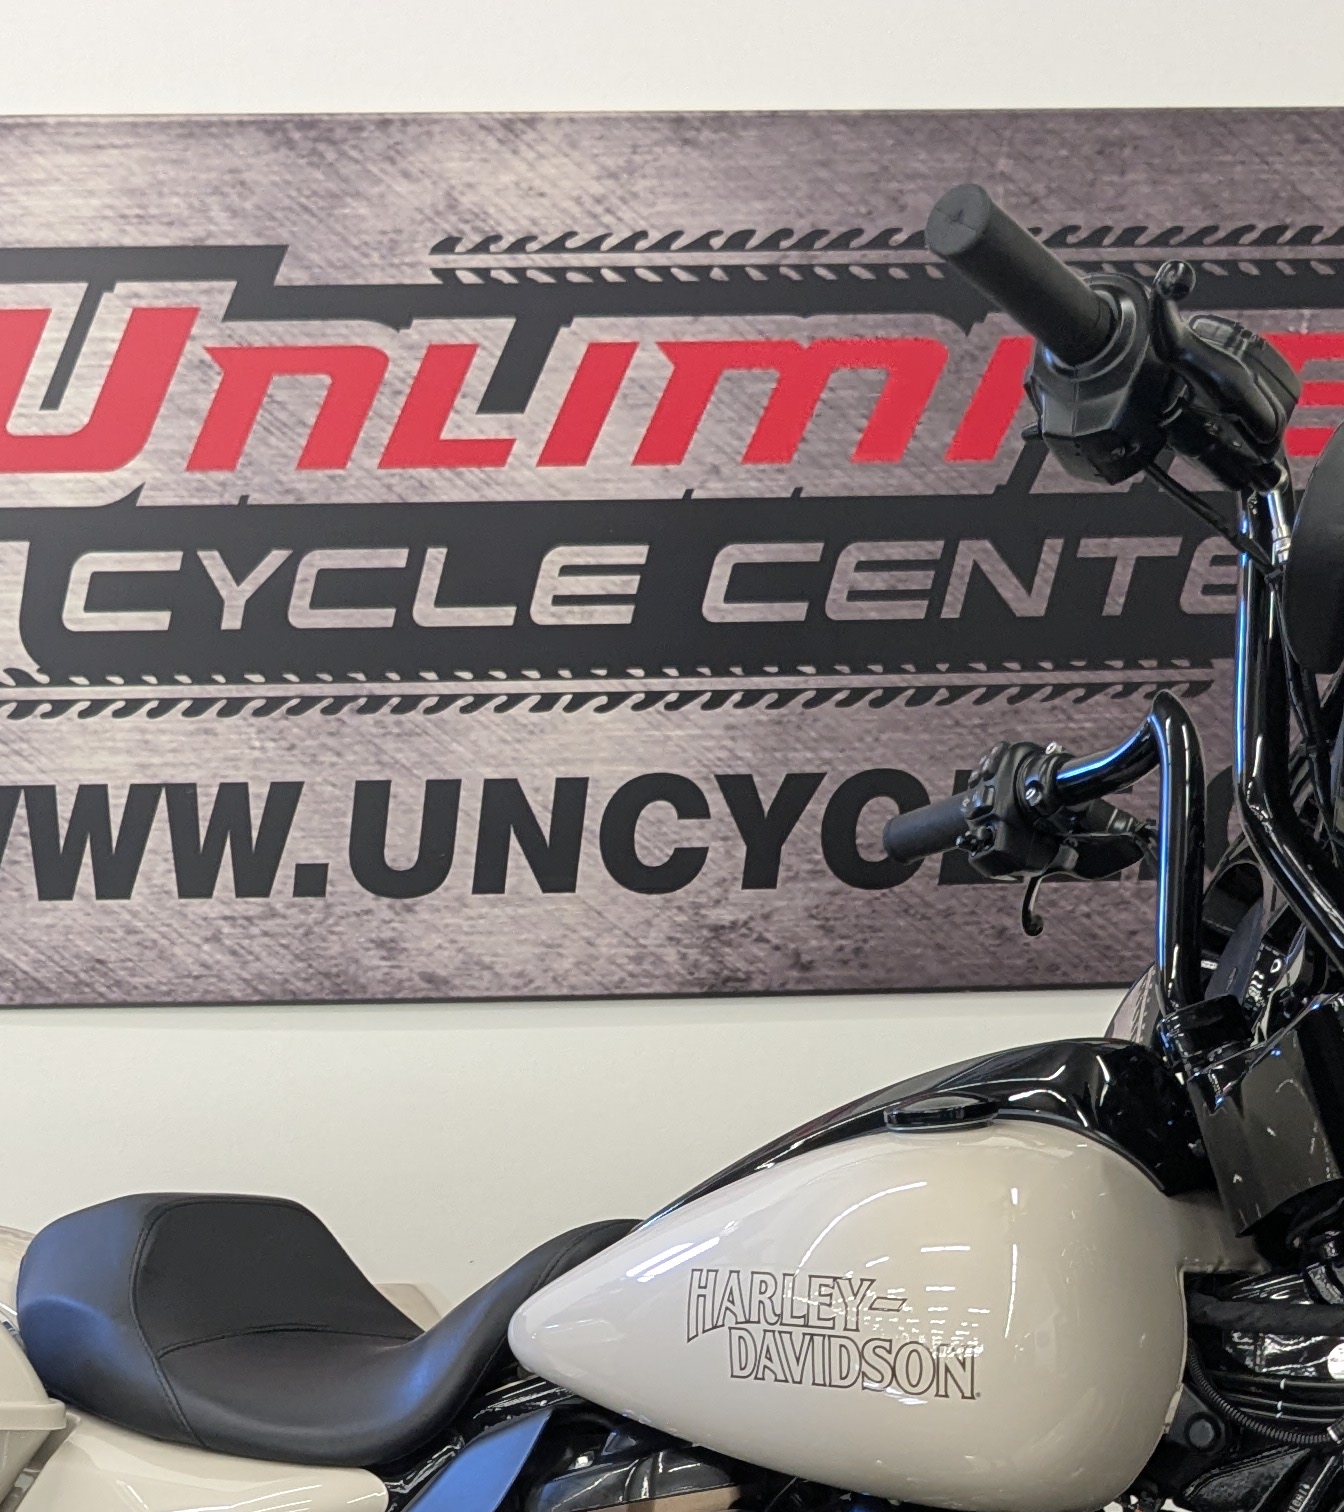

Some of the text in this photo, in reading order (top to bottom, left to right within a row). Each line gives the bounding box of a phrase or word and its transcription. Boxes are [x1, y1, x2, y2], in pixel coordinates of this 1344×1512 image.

[62, 537, 1240, 632] CYCLE CENTE
[728, 1326, 977, 1400] DAVIDSON
